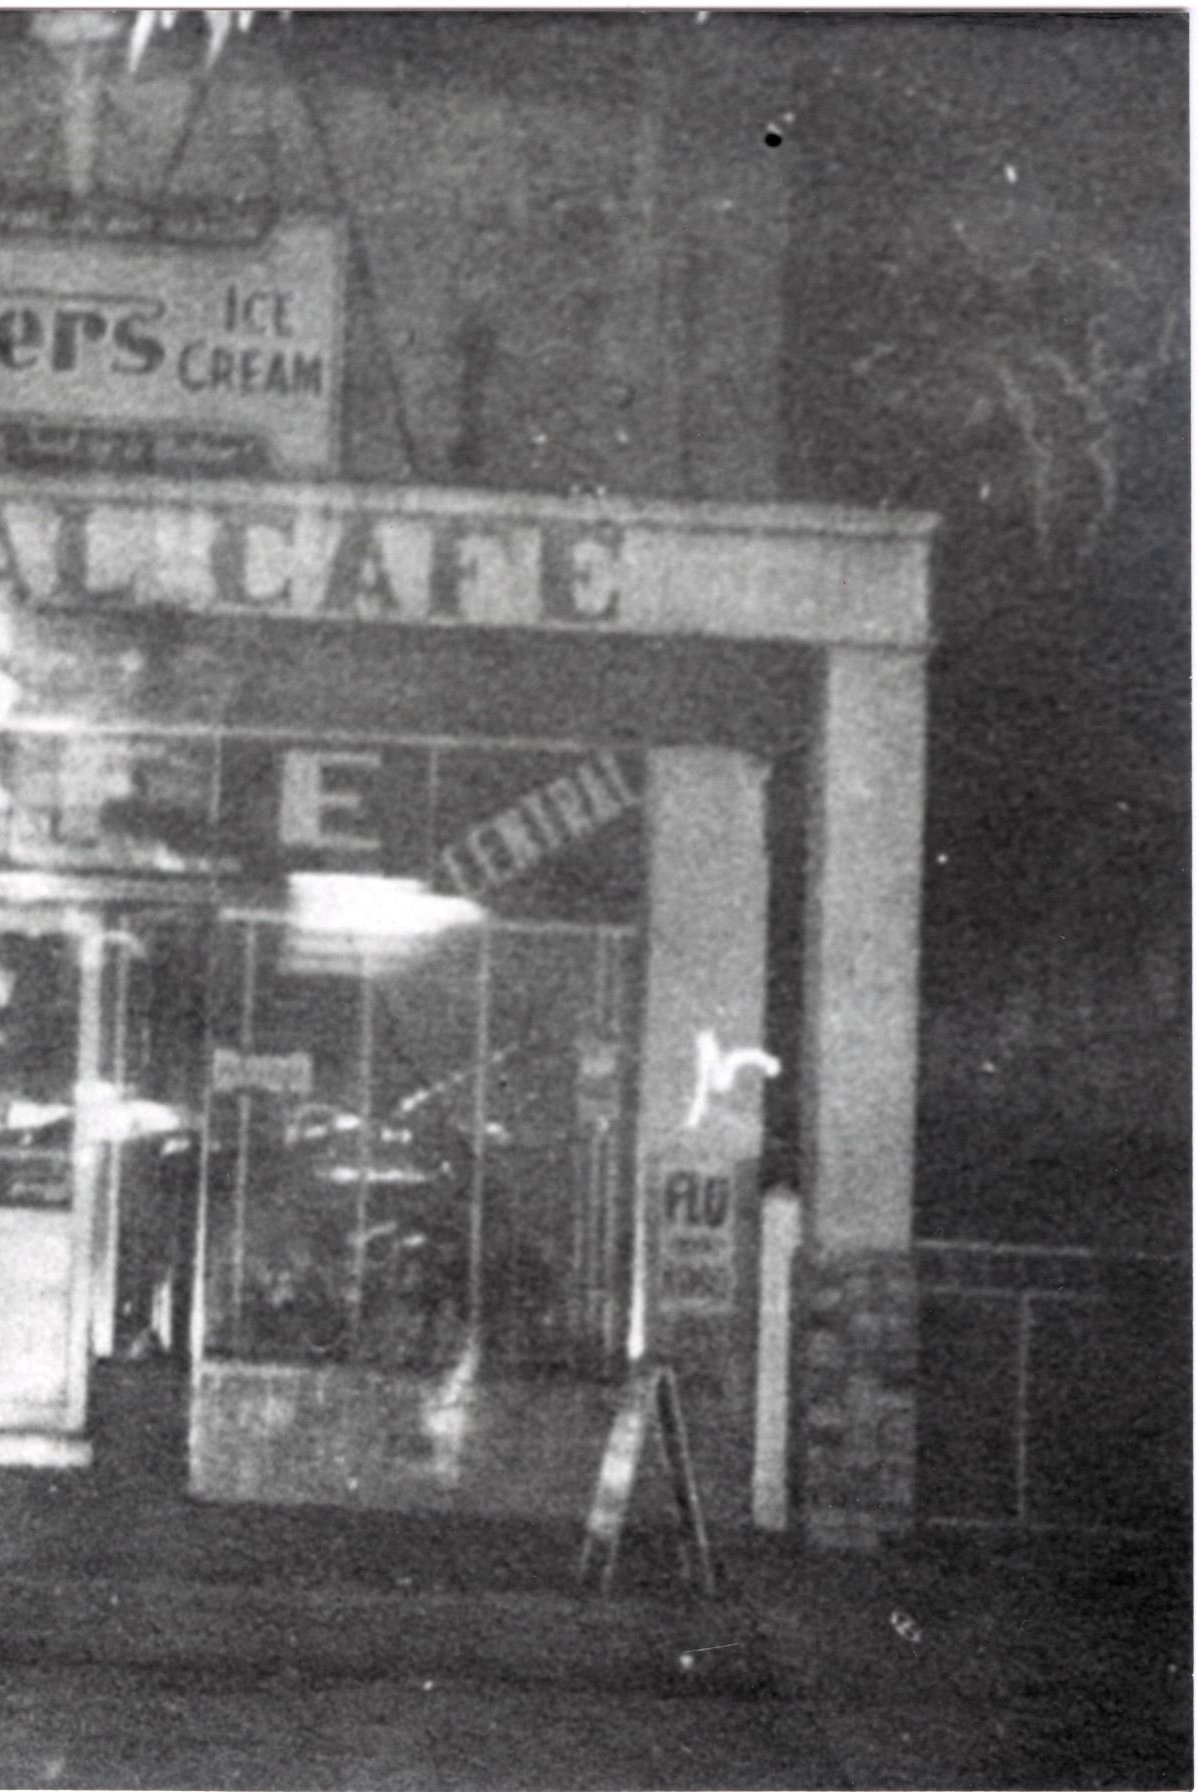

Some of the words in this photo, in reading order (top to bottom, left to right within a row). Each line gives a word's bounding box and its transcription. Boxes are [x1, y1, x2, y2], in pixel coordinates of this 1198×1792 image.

[223, 283, 295, 338] ICE
[176, 341, 324, 398] CREAM
[207, 502, 626, 622] CAFE
[439, 750, 638, 897] CENTRAL
